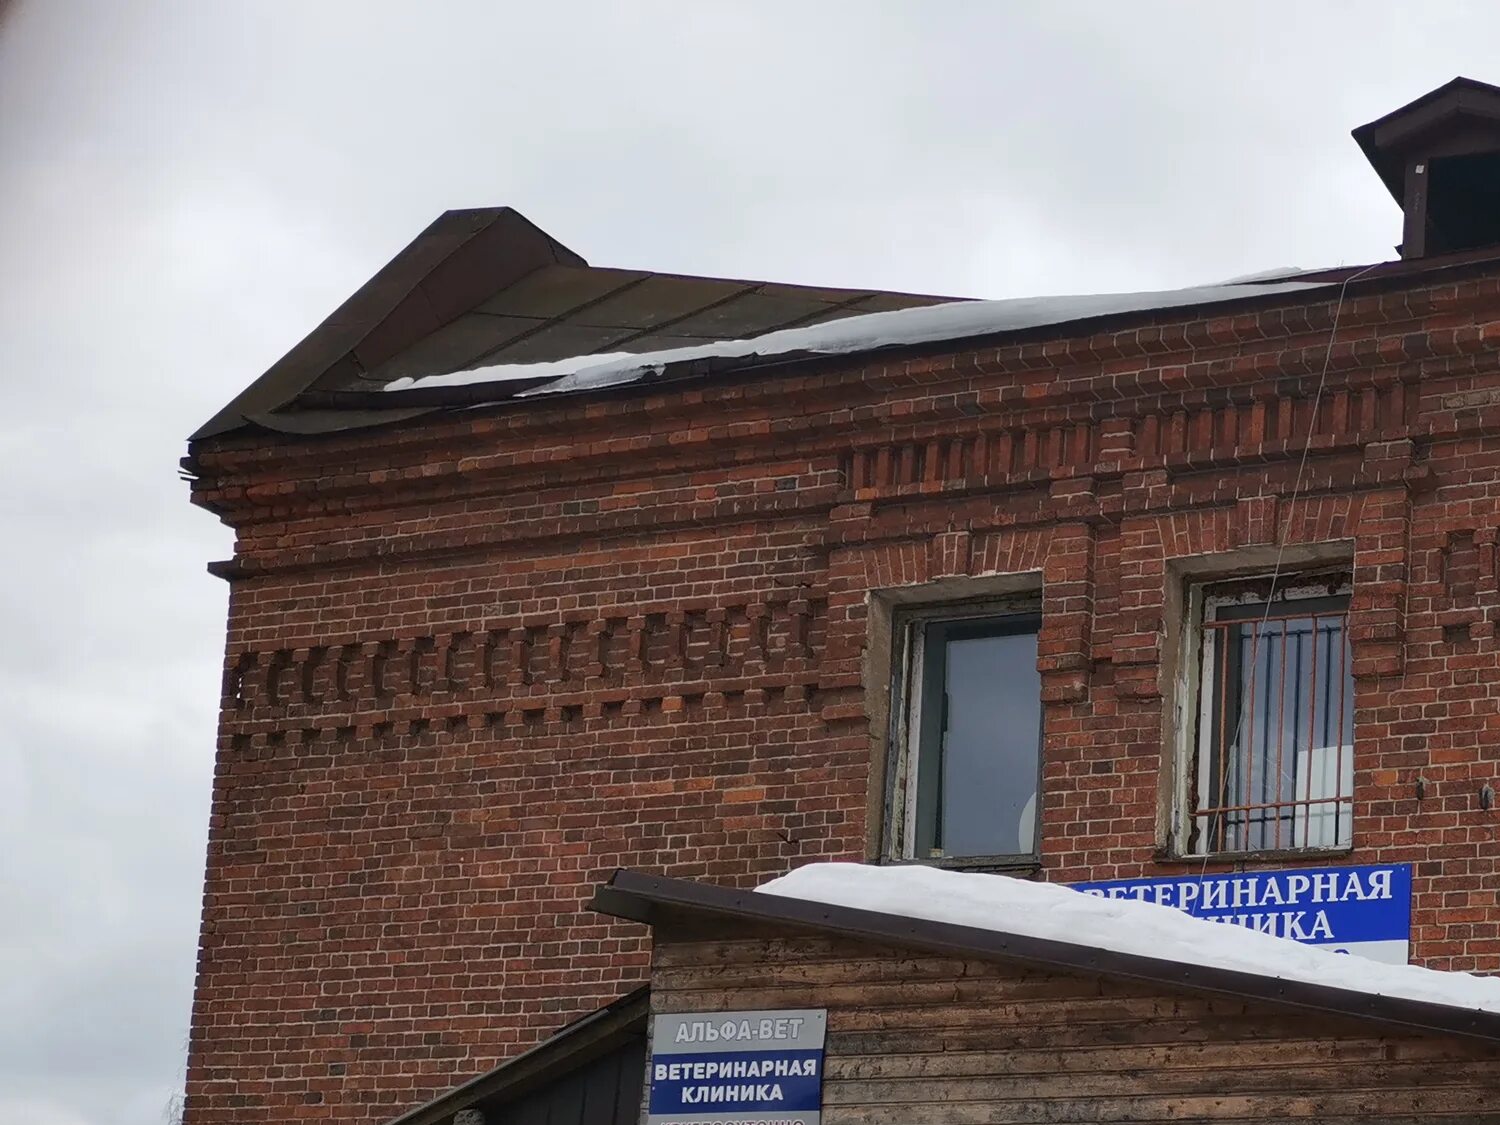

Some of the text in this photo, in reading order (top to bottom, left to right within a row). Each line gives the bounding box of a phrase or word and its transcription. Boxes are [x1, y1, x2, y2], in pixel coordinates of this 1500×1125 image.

[674, 1018, 804, 1043] АЛЬФА-ВЕТ
[655, 1059, 816, 1081] ВЕТЕРИНАРНАЯ
[681, 1084, 783, 1103] КЛИНИКА
